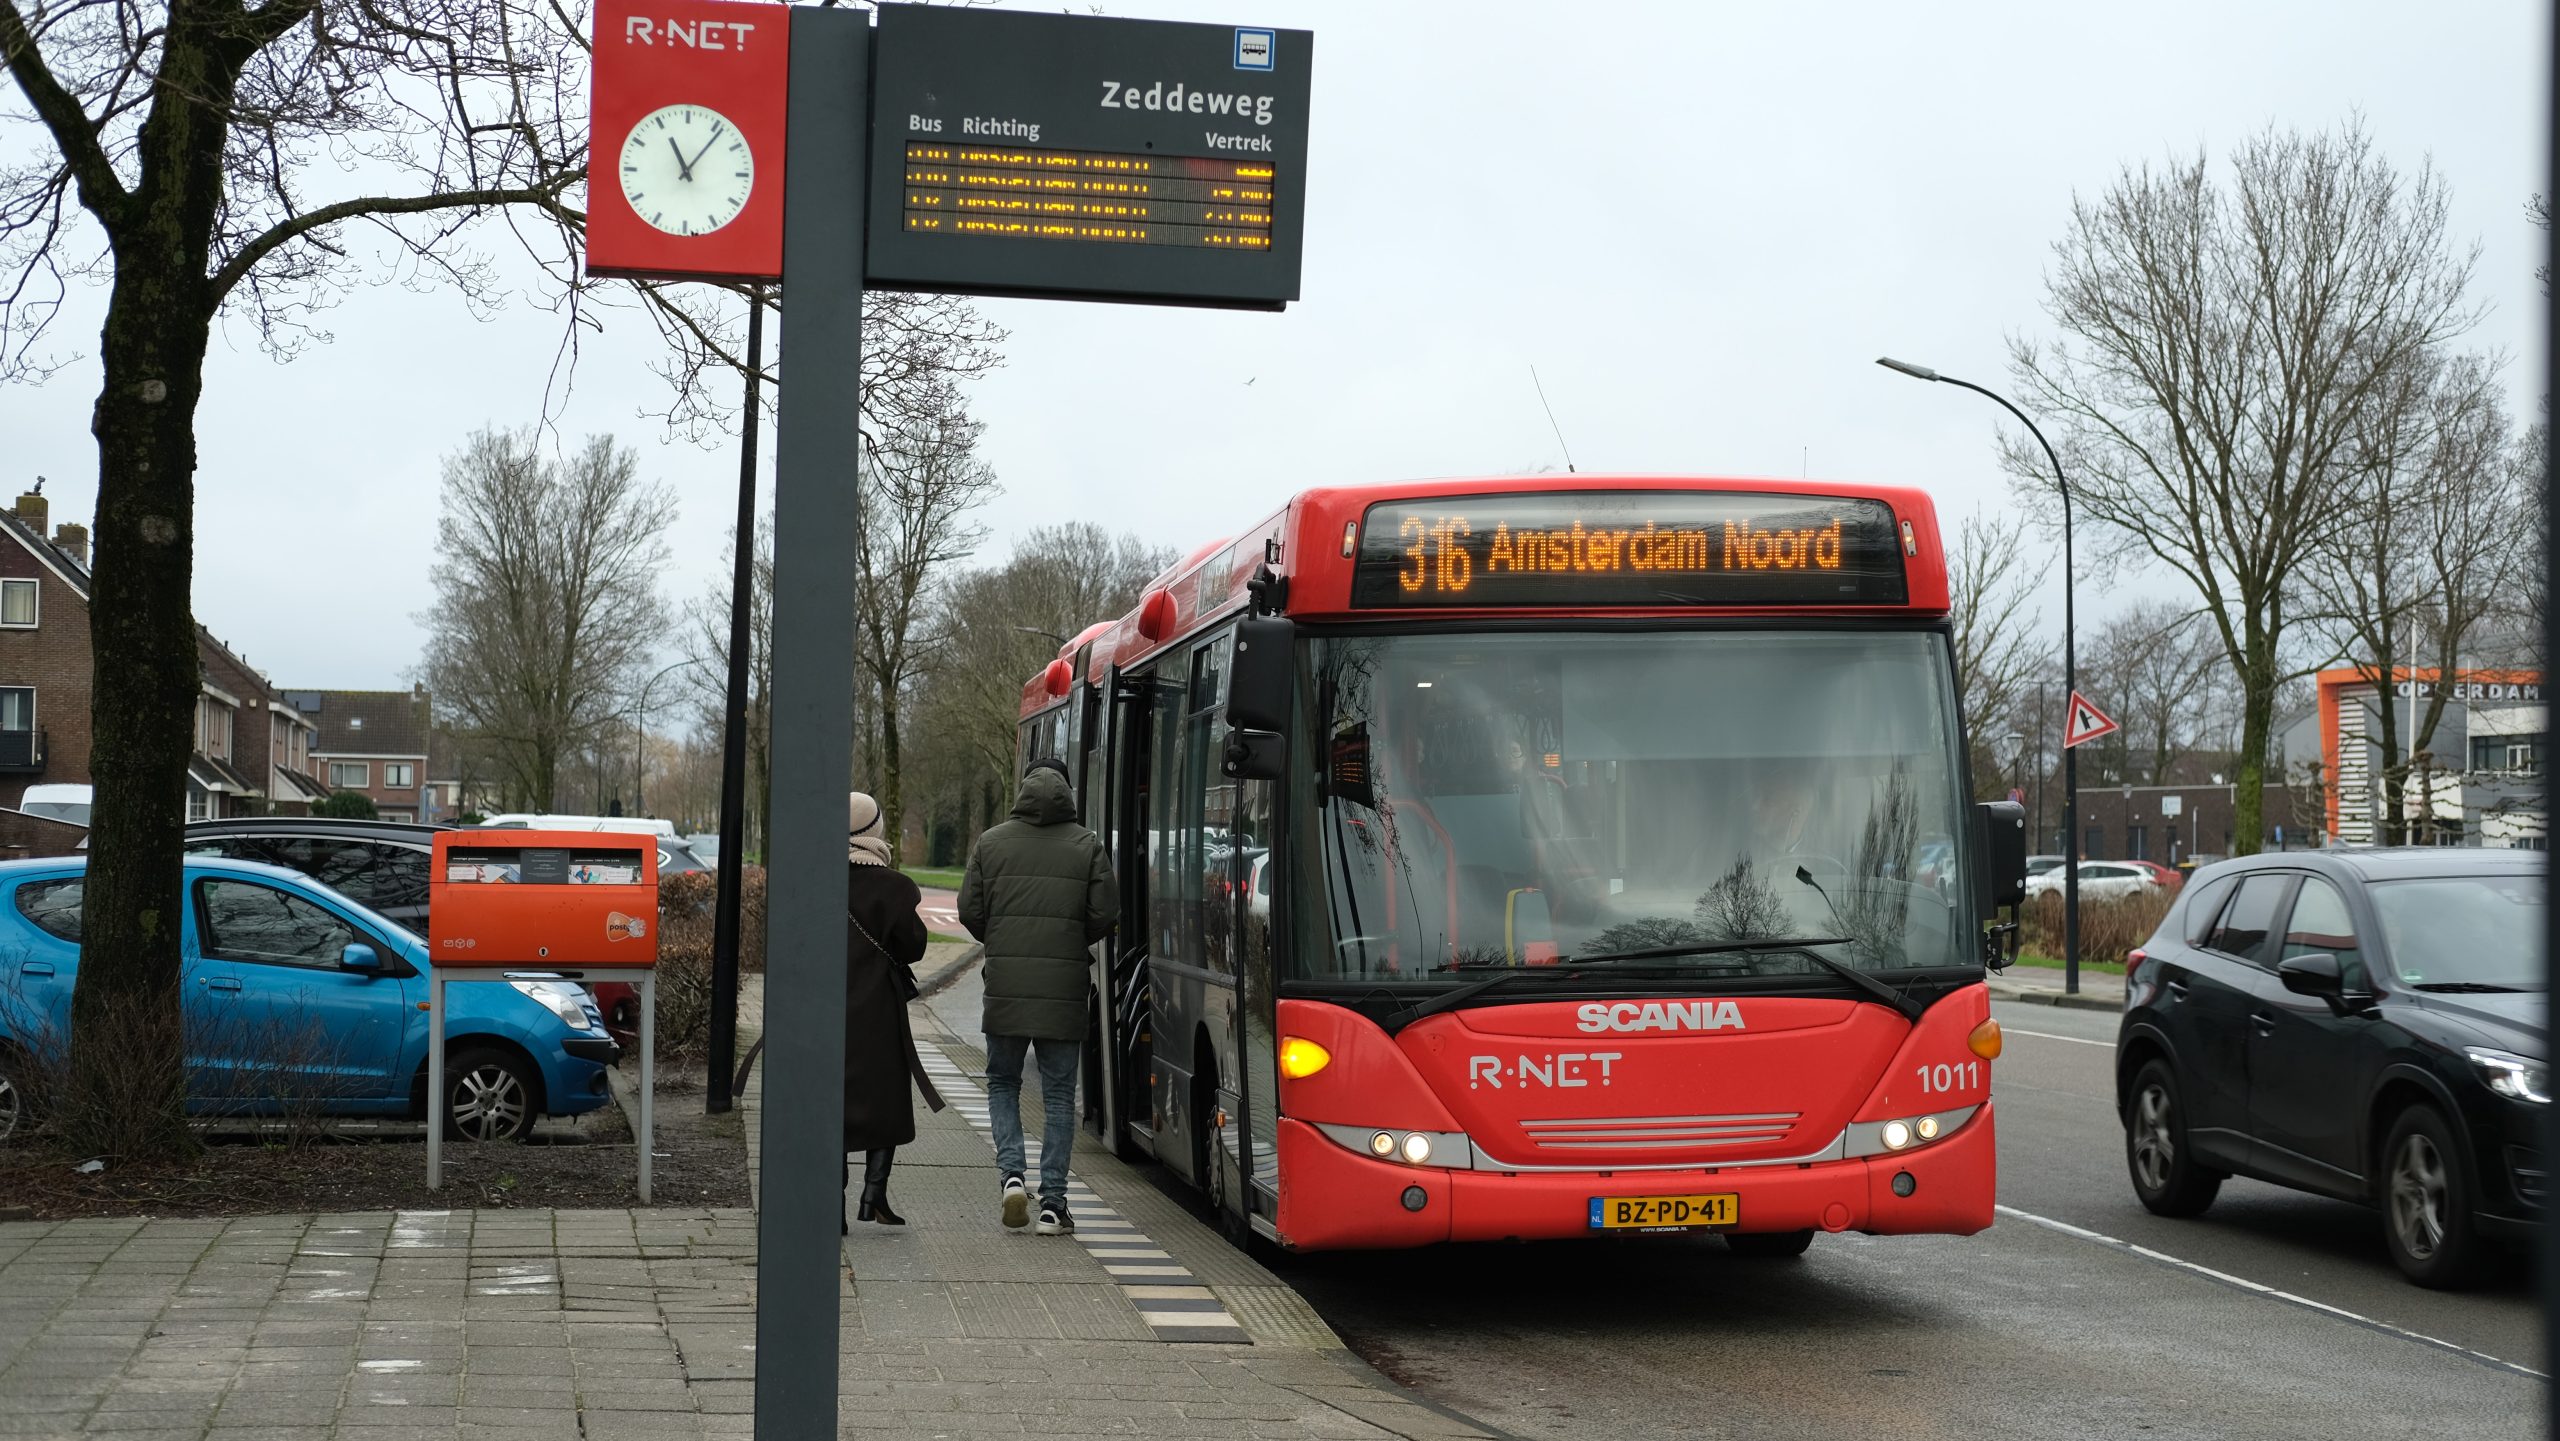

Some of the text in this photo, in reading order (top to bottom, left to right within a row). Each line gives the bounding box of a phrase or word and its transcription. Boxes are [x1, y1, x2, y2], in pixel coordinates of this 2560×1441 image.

[1101, 81, 1274, 125] Zeddeweg
[909, 114, 1041, 142] Bus Richting
[1205, 132, 1273, 152] Vertrek
[1400, 516, 1842, 592] 316 Amsterdam Noord
[2398, 682, 2539, 699] OPERDAM
[1577, 1001, 1746, 1032] SCANIA
[1917, 1061, 1979, 1093] 1011
[1591, 1198, 1725, 1224] NL BZ-PD-41
